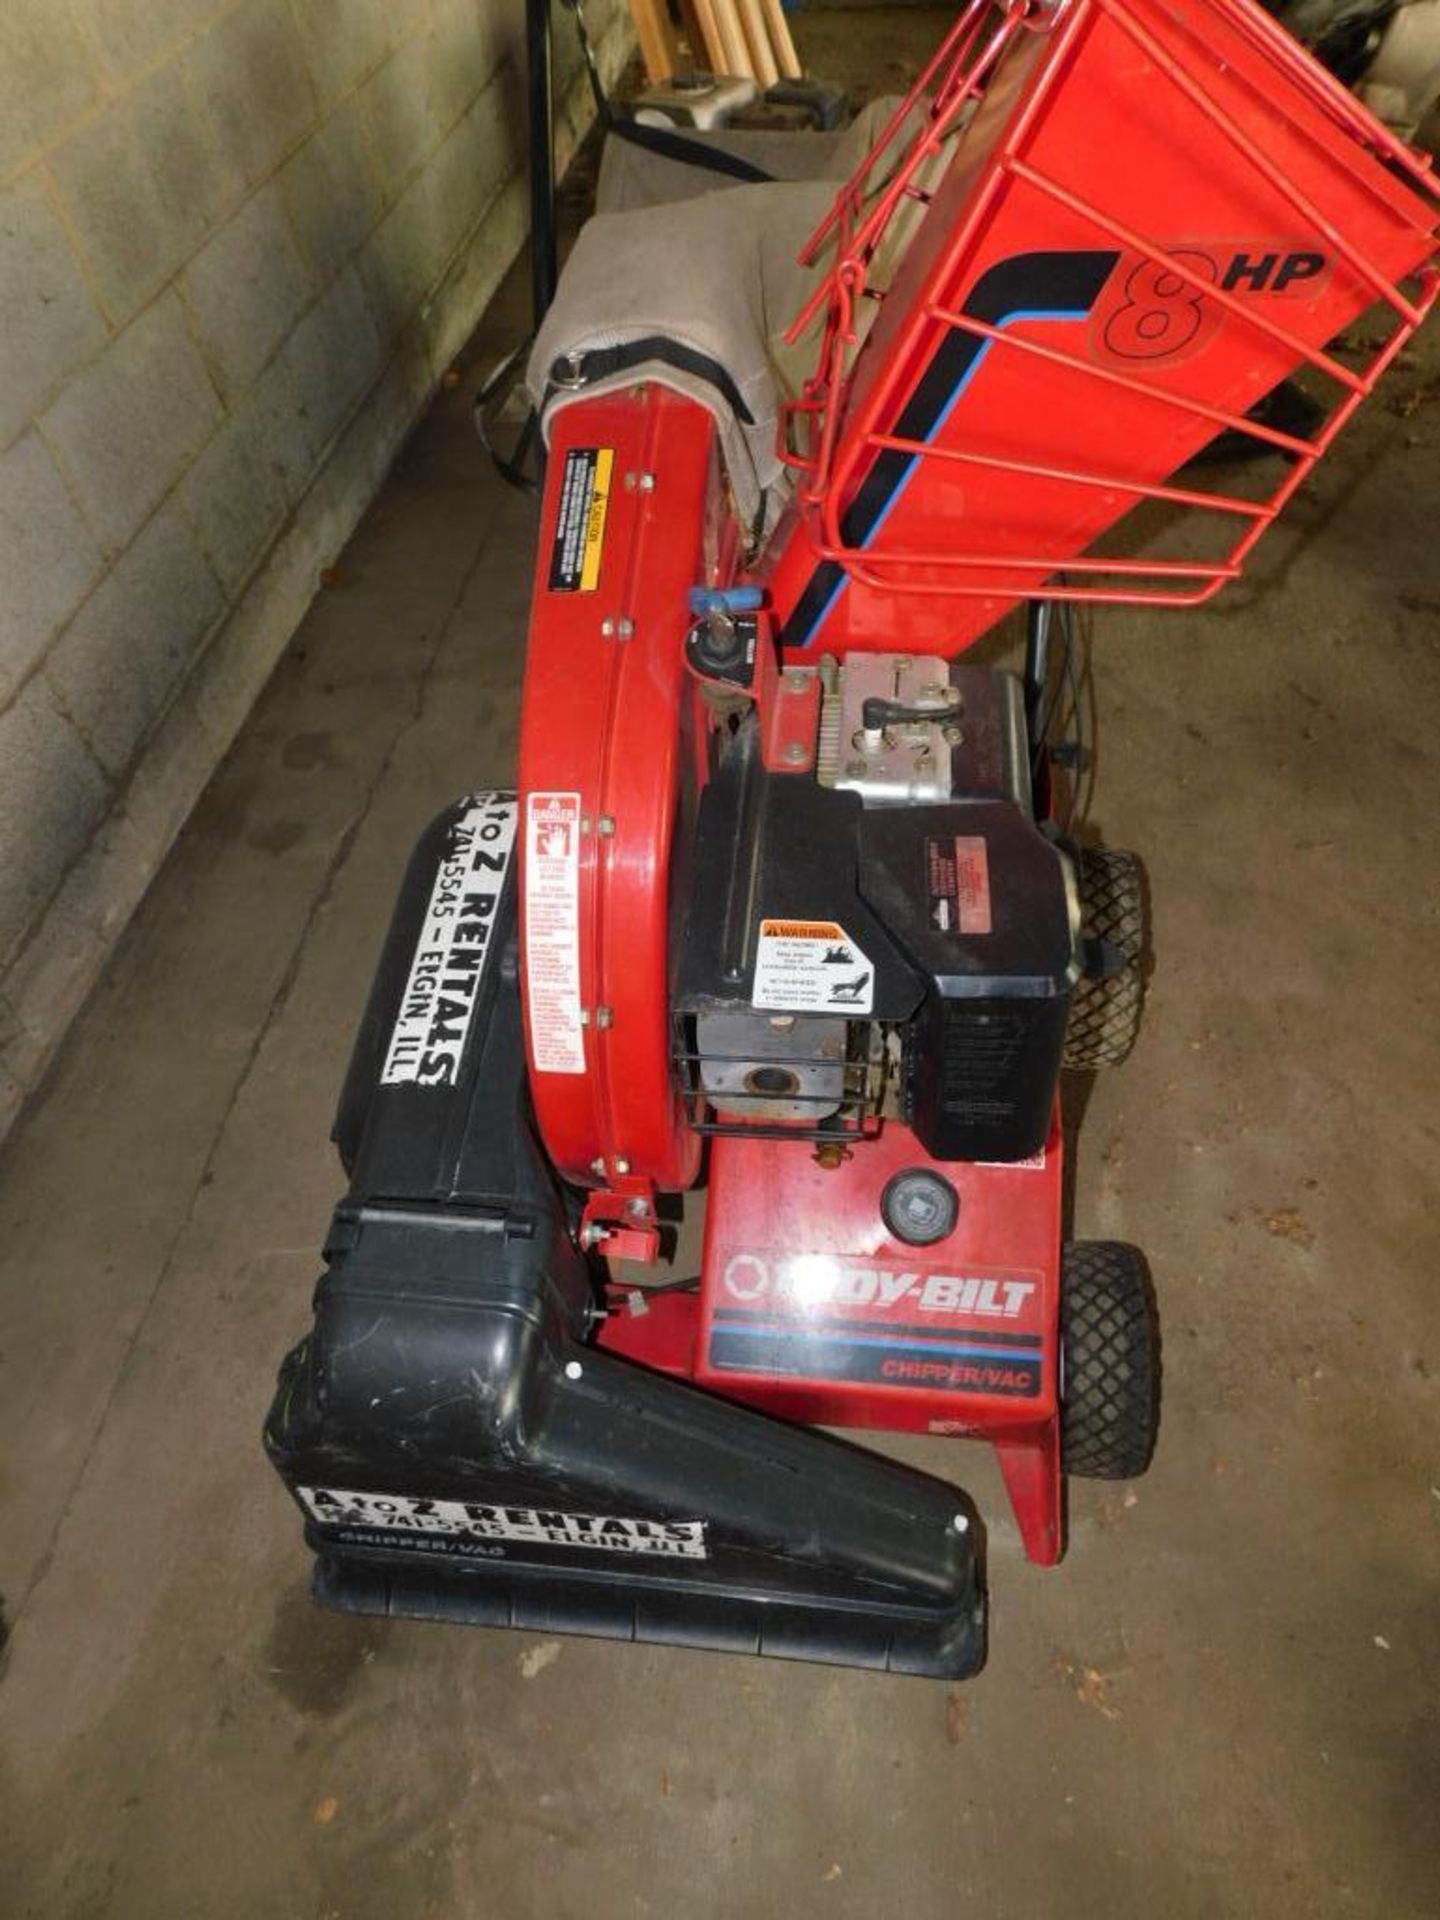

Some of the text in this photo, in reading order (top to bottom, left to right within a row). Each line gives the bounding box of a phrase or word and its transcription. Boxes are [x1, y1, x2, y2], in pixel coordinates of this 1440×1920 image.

[1220, 253, 1326, 291] HP
[480, 810, 511, 842] to
[471, 850, 507, 872] Z
[418, 892, 497, 1087] RENTALS
[880, 1358, 1031, 1388] CHIPPER/VAC
[313, 1491, 344, 1508] A
[407, 1499, 441, 1517] Z
[464, 1505, 695, 1542] RENTALS
